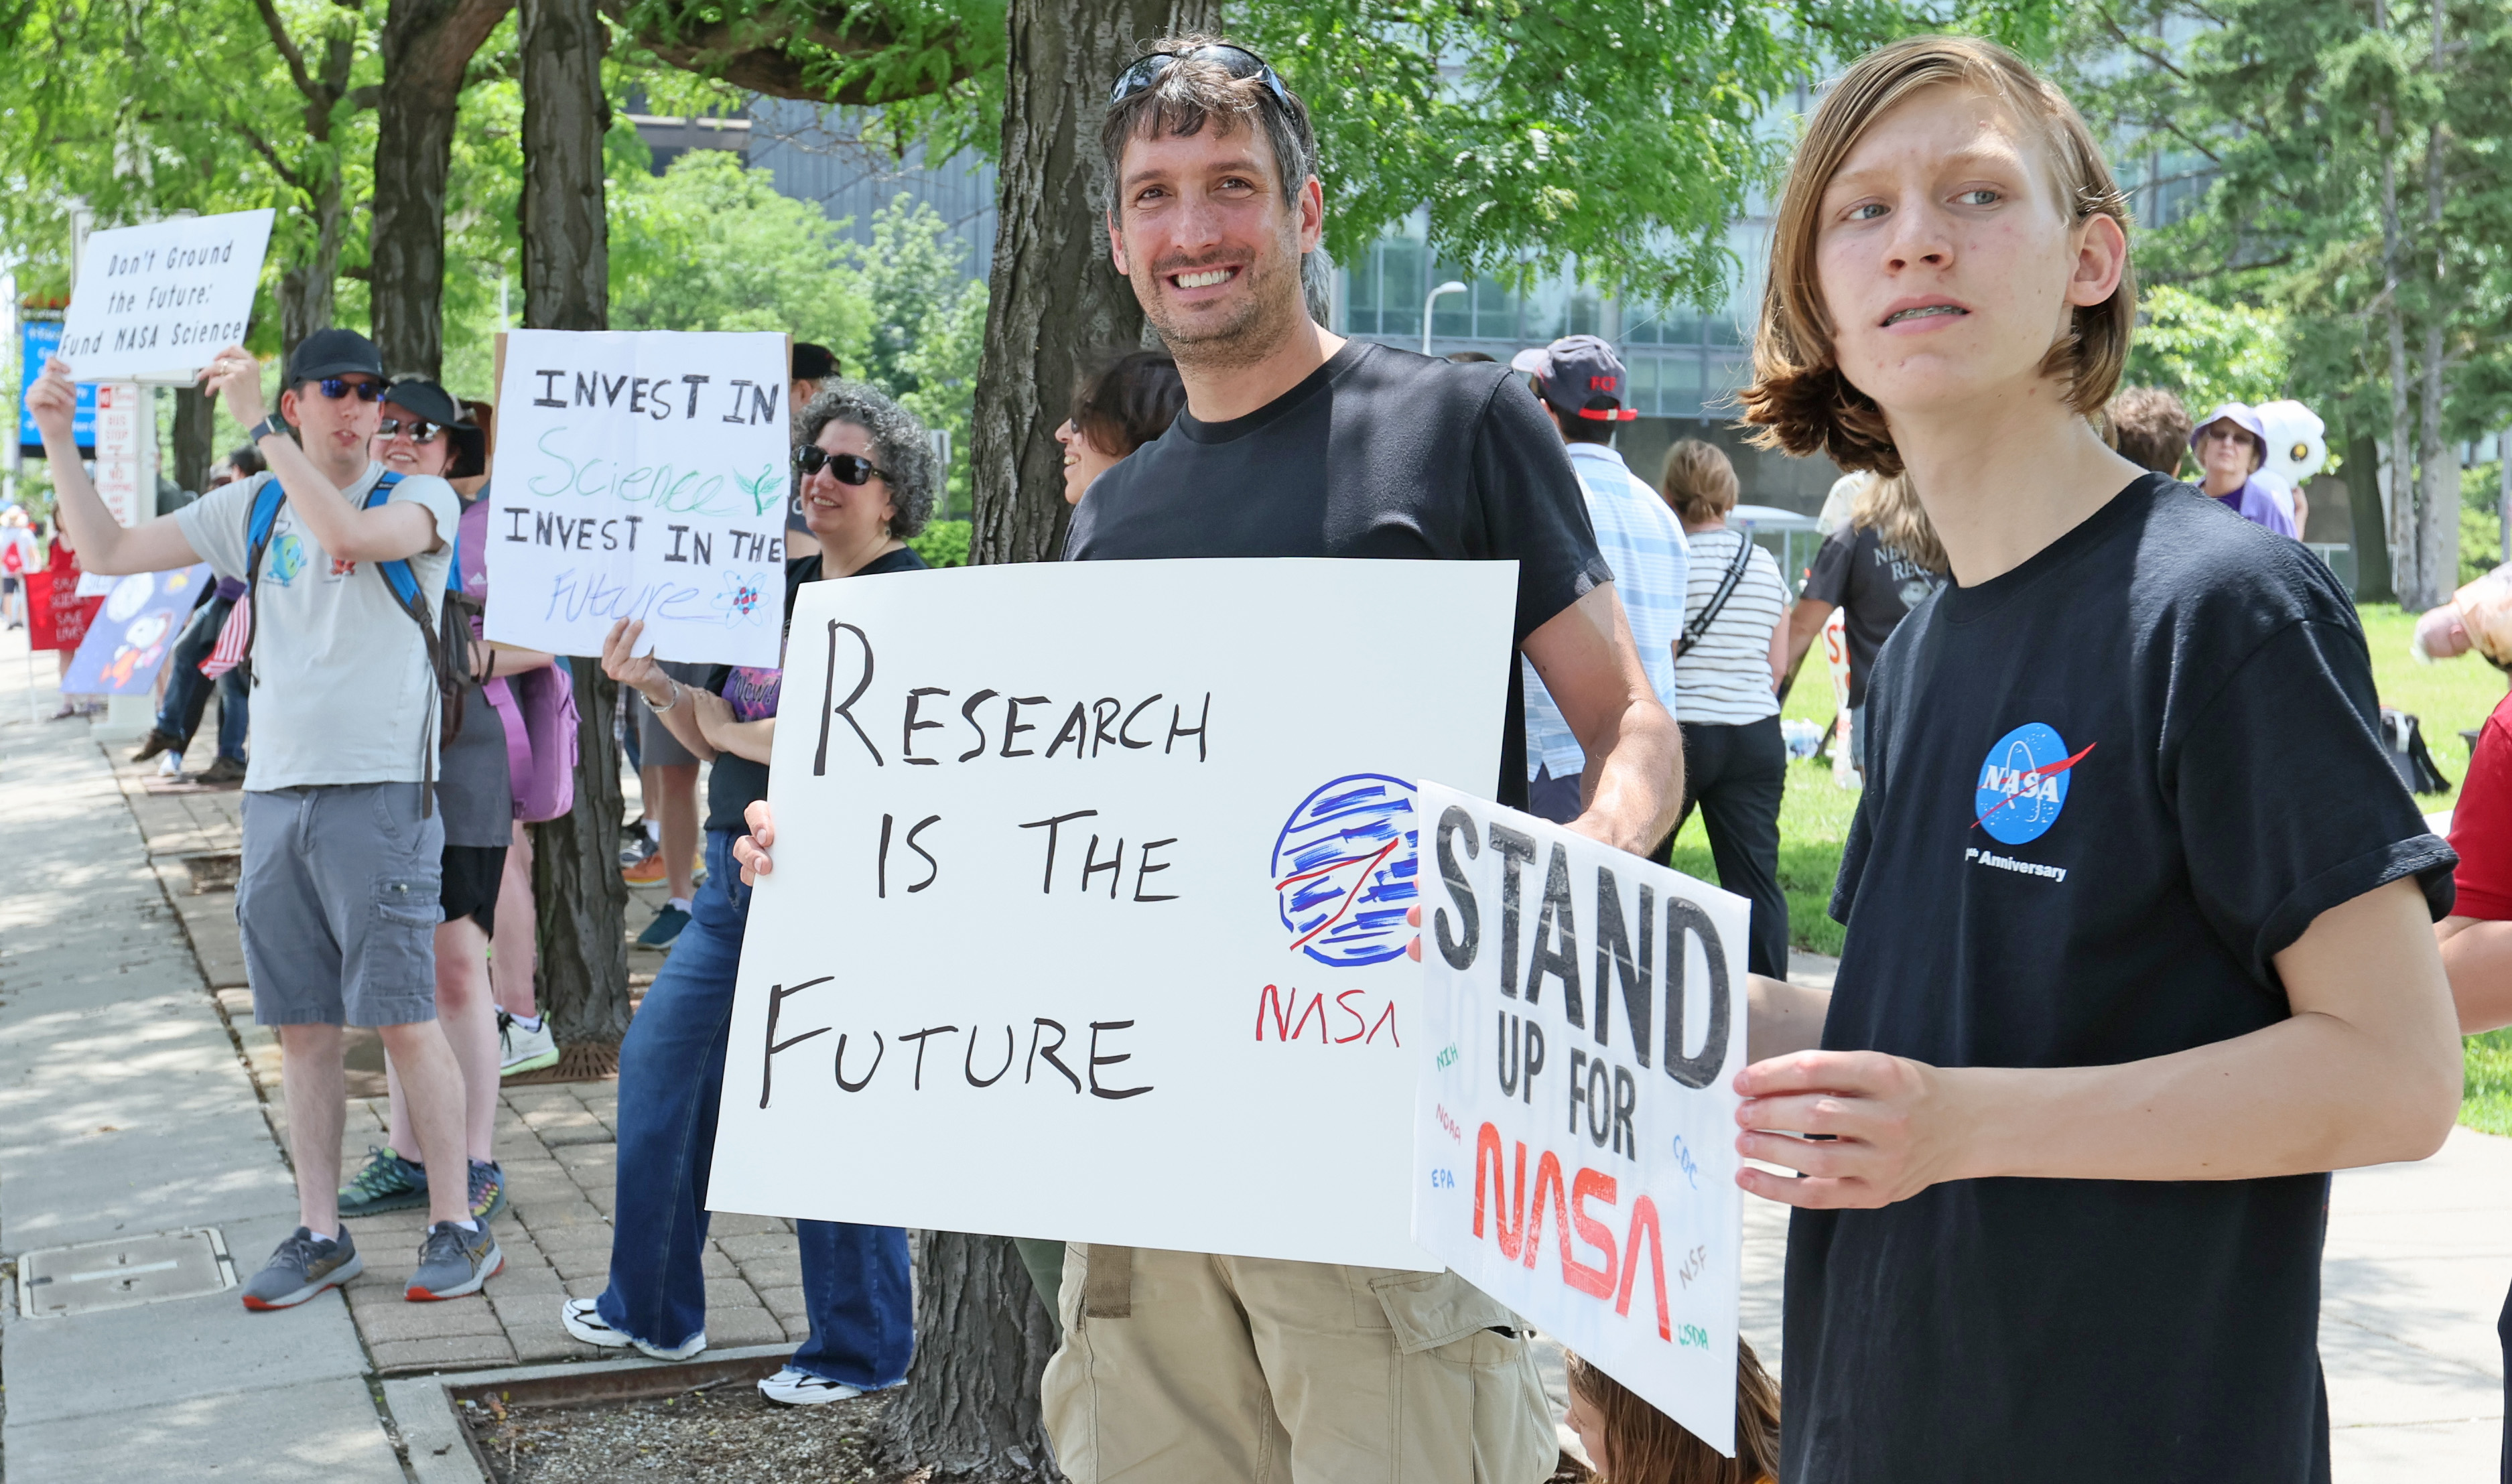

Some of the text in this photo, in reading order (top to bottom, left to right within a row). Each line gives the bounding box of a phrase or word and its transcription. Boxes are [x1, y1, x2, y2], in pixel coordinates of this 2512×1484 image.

[108, 239, 233, 277] Don't Ground
[108, 284, 212, 314] the Future:
[60, 331, 103, 356] Fund
[114, 325, 158, 351] NASA
[172, 320, 242, 346] Science
[533, 369, 780, 425] INVEST IN
[528, 426, 742, 517] Science
[503, 507, 782, 566] INVEST IN THE
[545, 568, 726, 625] Future
[813, 618, 1211, 777] RESEARCH
[1982, 764, 2060, 803] NASA
[878, 809, 1181, 902] IS THE
[1978, 850, 2067, 882] Anniversary
[1435, 805, 1731, 1089] STAND
[759, 975, 1154, 1110] FUTURE
[1256, 984, 1400, 1048] NASA
[1437, 1042, 1459, 1073] NIH
[1498, 1009, 1636, 1162] UP FOR
[1436, 1103, 1461, 1146] NOAA
[1431, 1168, 1455, 1189] EPA
[1673, 1134, 1698, 1191] CDC
[1473, 1121, 1674, 1343] NASA
[1679, 1245, 1707, 1290] NSF
[1678, 1323, 1709, 1350] USDA
